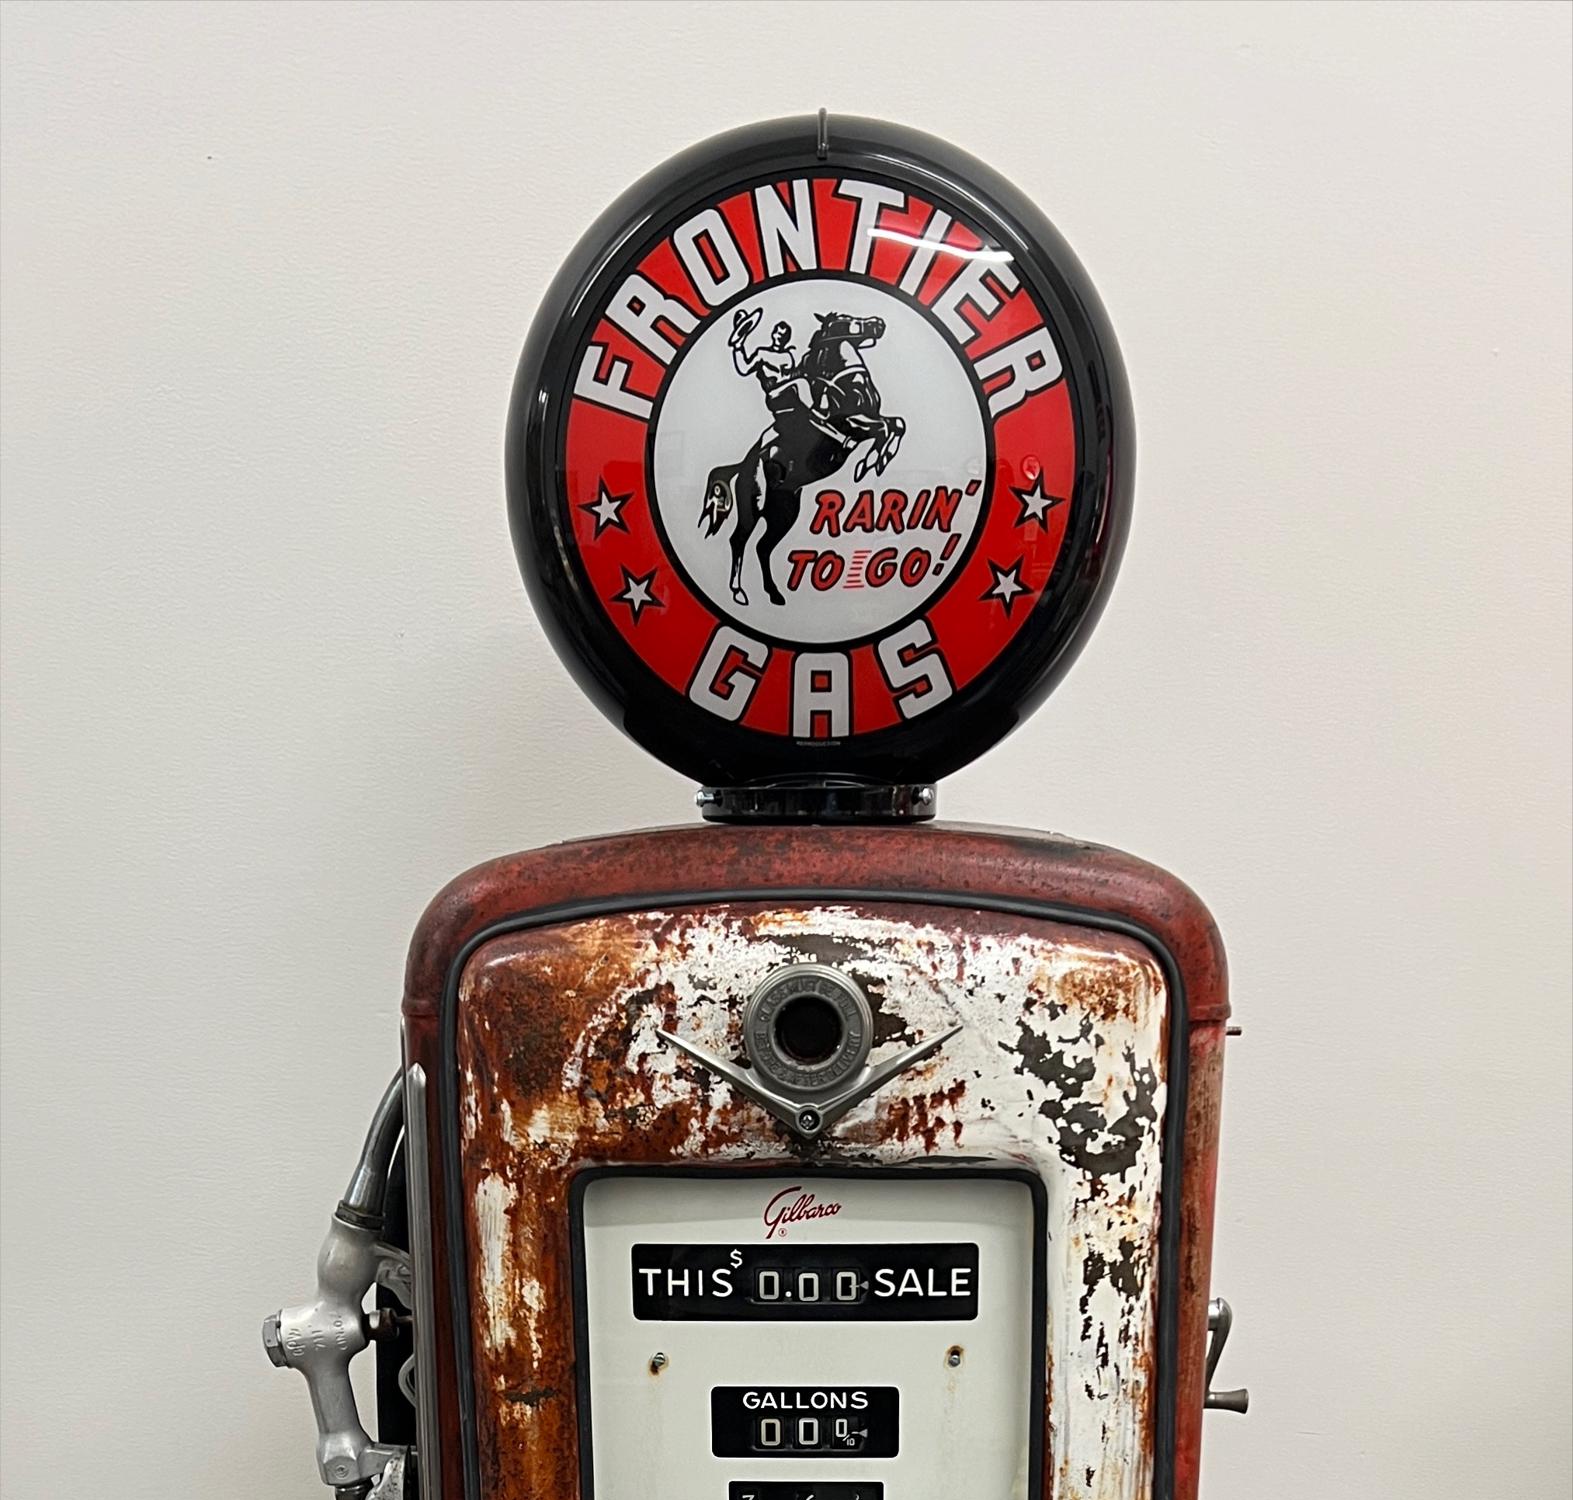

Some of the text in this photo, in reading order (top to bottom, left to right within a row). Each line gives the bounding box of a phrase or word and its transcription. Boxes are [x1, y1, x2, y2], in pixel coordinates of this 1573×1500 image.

[572, 178, 1063, 420] FRONTIER
[809, 479, 982, 537] RARIN'
[787, 533, 962, 591] TO GO!
[688, 618, 955, 738] GAS
[764, 1186, 841, 1239] Gilbarco
[639, 1268, 733, 1297] THIS
[730, 1249, 743, 1268] $
[874, 1268, 971, 1297] SALE
[742, 1391, 869, 1410] GALLONS
